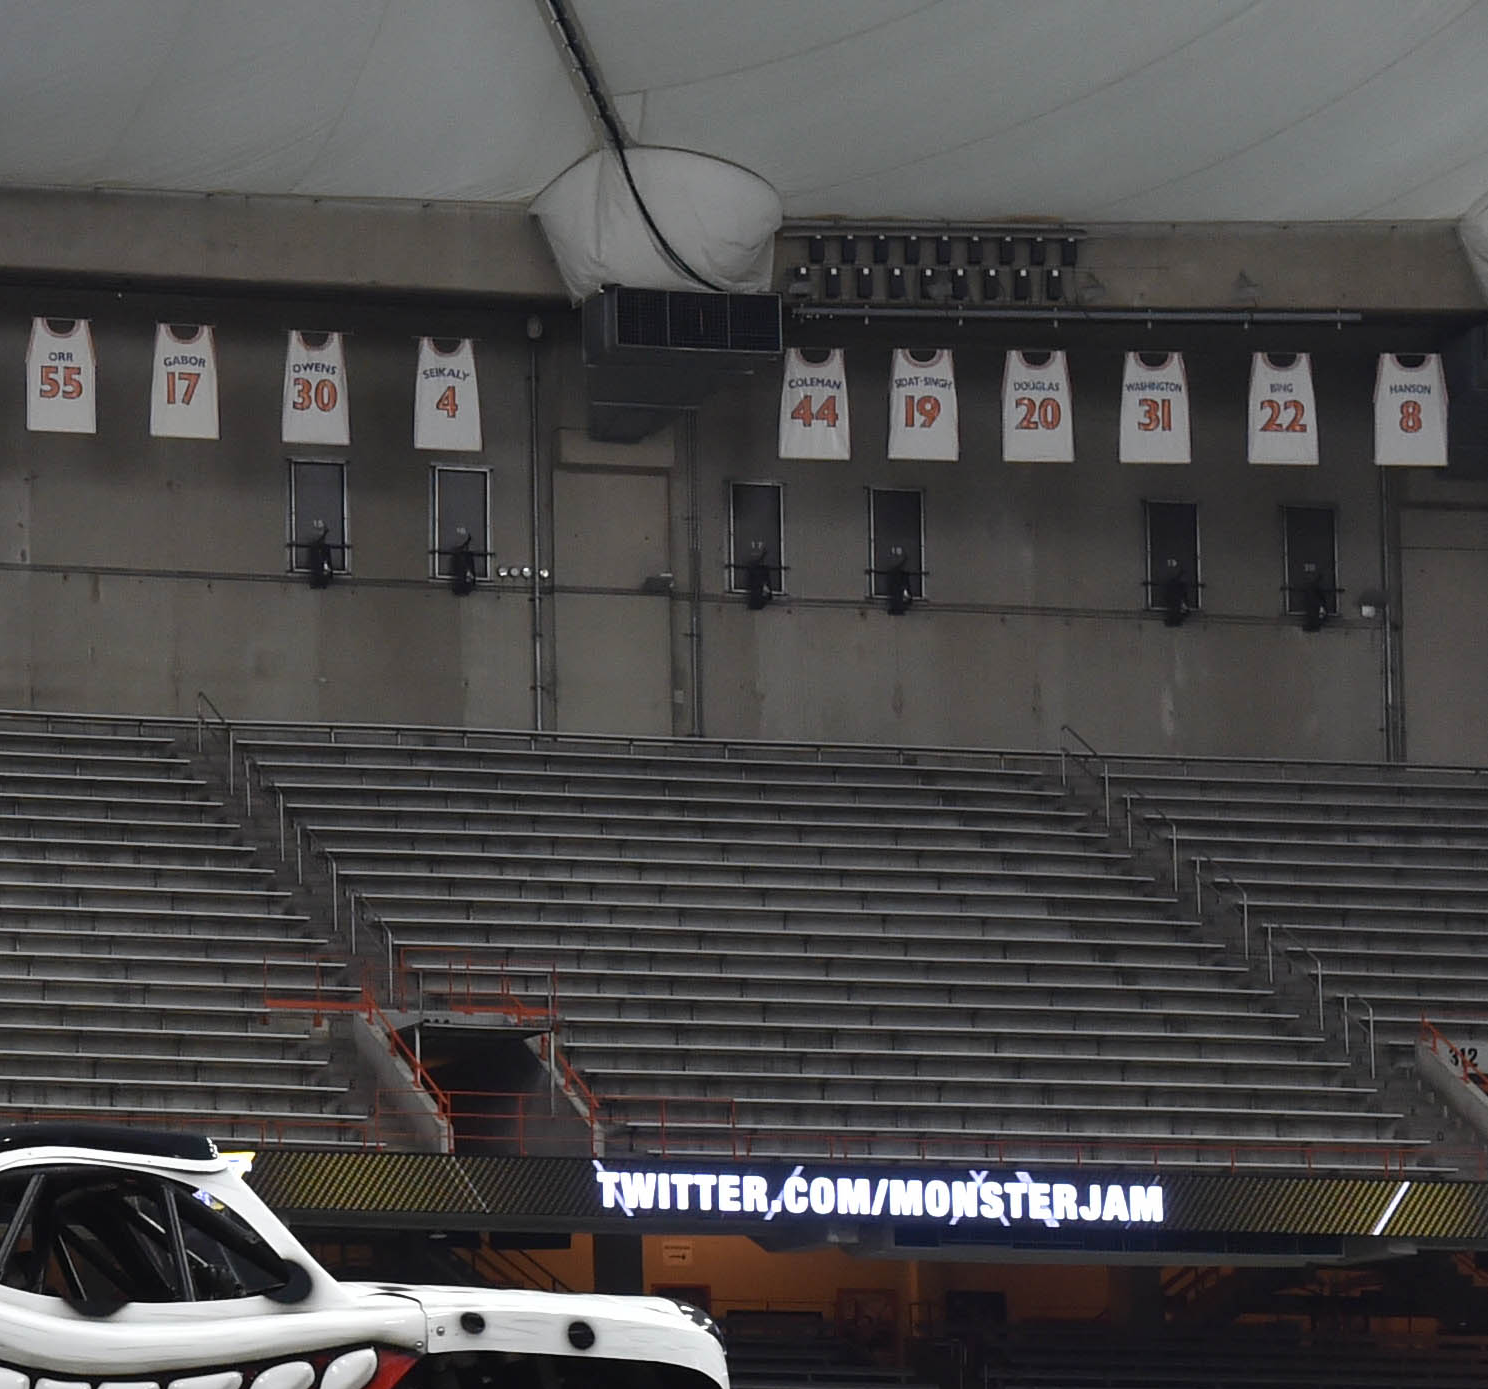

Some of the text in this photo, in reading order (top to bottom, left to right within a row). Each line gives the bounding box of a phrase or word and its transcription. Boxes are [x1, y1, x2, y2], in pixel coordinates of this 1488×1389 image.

[48, 351, 74, 363] ORR
[163, 355, 206, 369] GABOR
[292, 362, 337, 376] OWENS
[39, 365, 83, 399] 55
[166, 371, 201, 406] 17
[422, 367, 471, 382] SEIKALY
[788, 376, 843, 391] COLEMAN
[1013, 381, 1061, 393] DOUGLAS
[1125, 382, 1183, 394] WASHINGTON
[1389, 383, 1433, 396] HANSON
[292, 377, 338, 412] 30
[435, 385, 459, 418] 4
[790, 394, 840, 428] 44
[903, 394, 942, 429] 19
[1014, 397, 1062, 430] 20
[1137, 397, 1173, 432] 31
[1258, 399, 1308, 433] 22
[1398, 399, 1424, 434] 8
[1448, 1047, 1478, 1069] 312
[596, 1171, 1164, 1223] TWITTER.COM/MONSTERJAM
